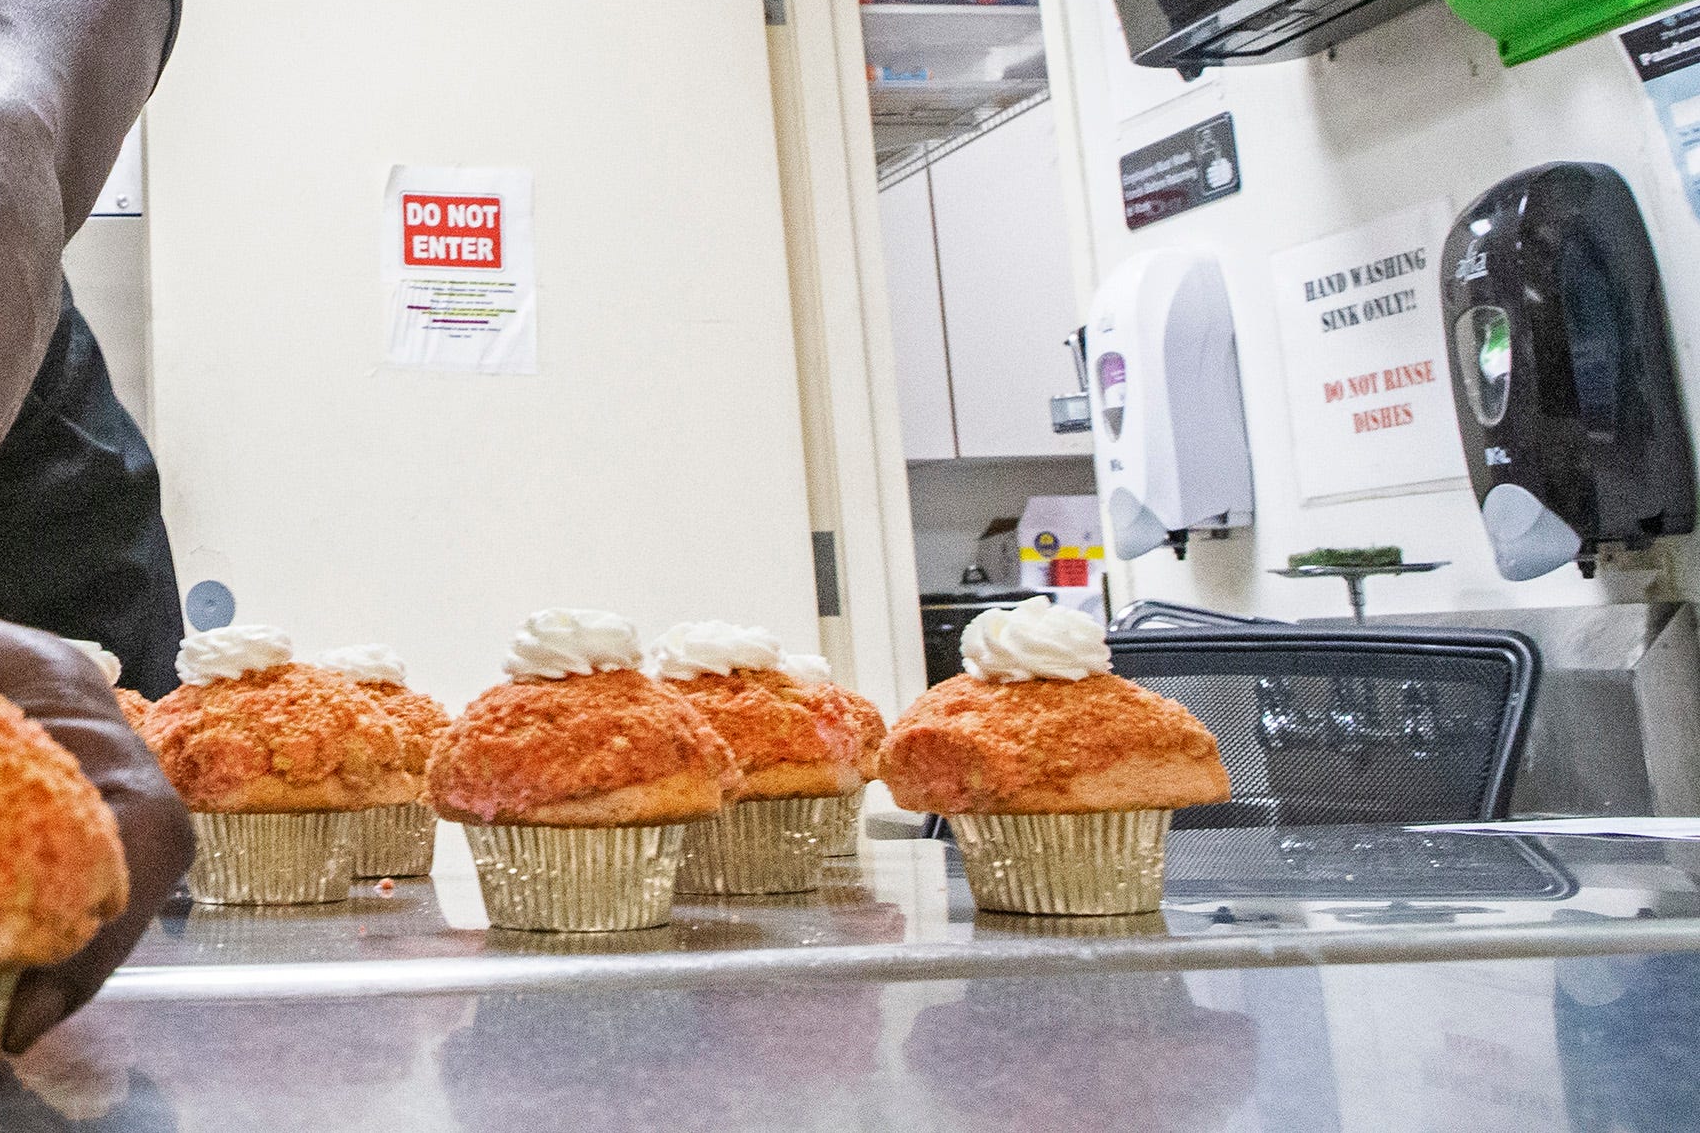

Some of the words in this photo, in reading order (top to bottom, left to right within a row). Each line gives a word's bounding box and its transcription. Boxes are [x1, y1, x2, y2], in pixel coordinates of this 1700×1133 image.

[406, 202, 441, 227] DO
[447, 203, 499, 229] NOT
[412, 234, 494, 261] ENTER
[1304, 272, 1347, 302] HAND
[1350, 247, 1427, 288] WASHING
[1321, 304, 1359, 333] SINK
[1363, 289, 1417, 322] ONLY!!
[1323, 380, 1344, 404] DO
[1347, 372, 1378, 398] NOT
[1383, 359, 1436, 391] RINSE
[1352, 403, 1414, 434] DISHES
